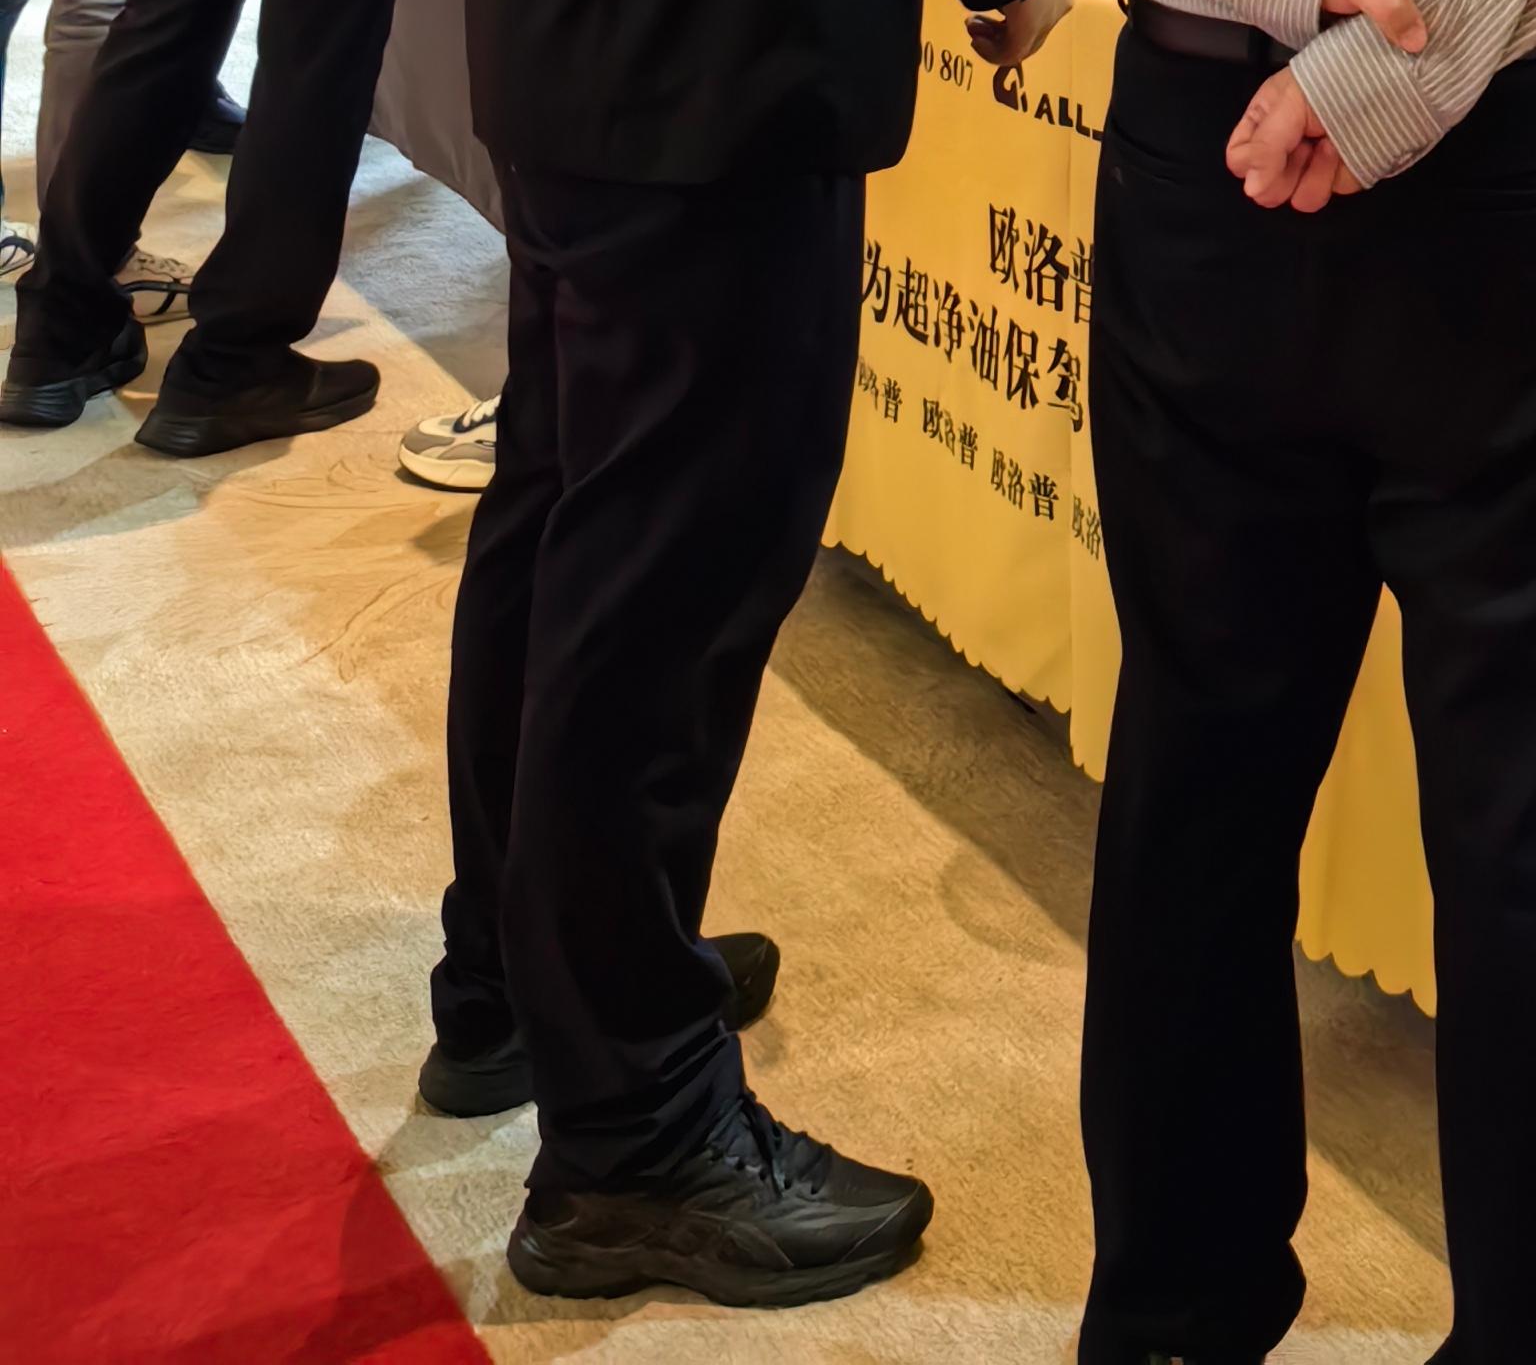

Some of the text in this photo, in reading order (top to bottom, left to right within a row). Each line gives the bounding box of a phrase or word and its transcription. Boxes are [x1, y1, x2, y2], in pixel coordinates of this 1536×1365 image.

[940, 49, 973, 92] 807
[861, 239, 1084, 433] 为超净油保驾
[990, 447, 1060, 522] 欧洛普
